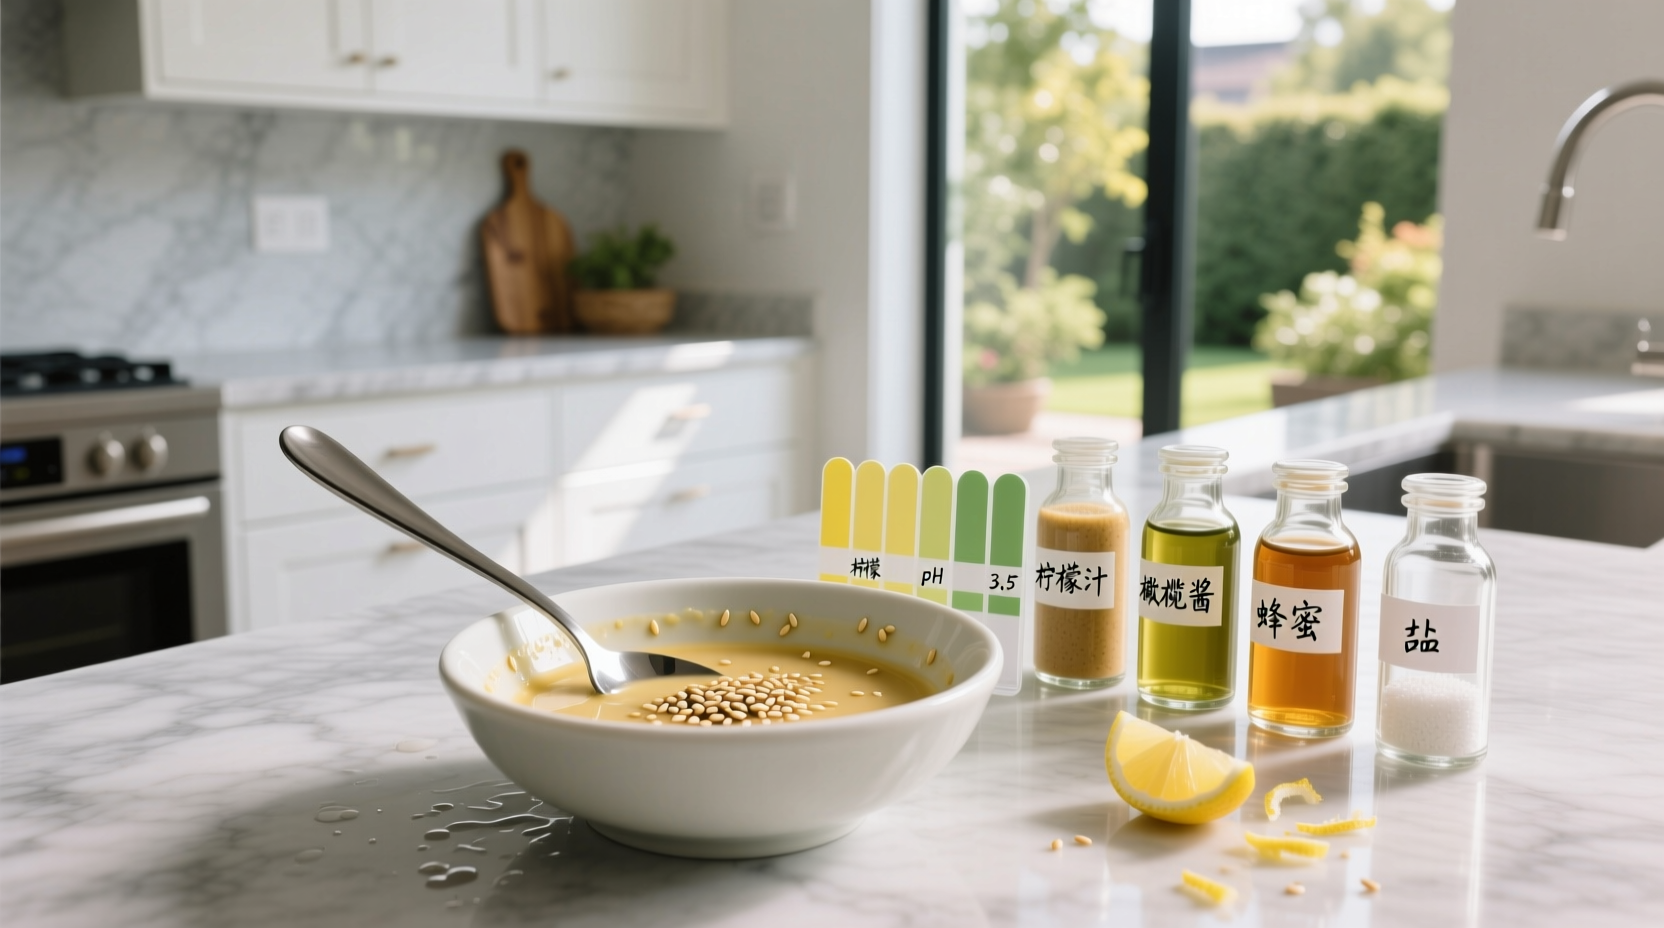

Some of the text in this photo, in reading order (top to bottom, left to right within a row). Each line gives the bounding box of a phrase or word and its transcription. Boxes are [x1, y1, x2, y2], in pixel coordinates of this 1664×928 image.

[921, 567, 943, 586] pH
[989, 573, 1019, 591] 3.5
[1035, 561, 1108, 597] 柠檬汁
[1256, 598, 1323, 641] 蜂蜜
